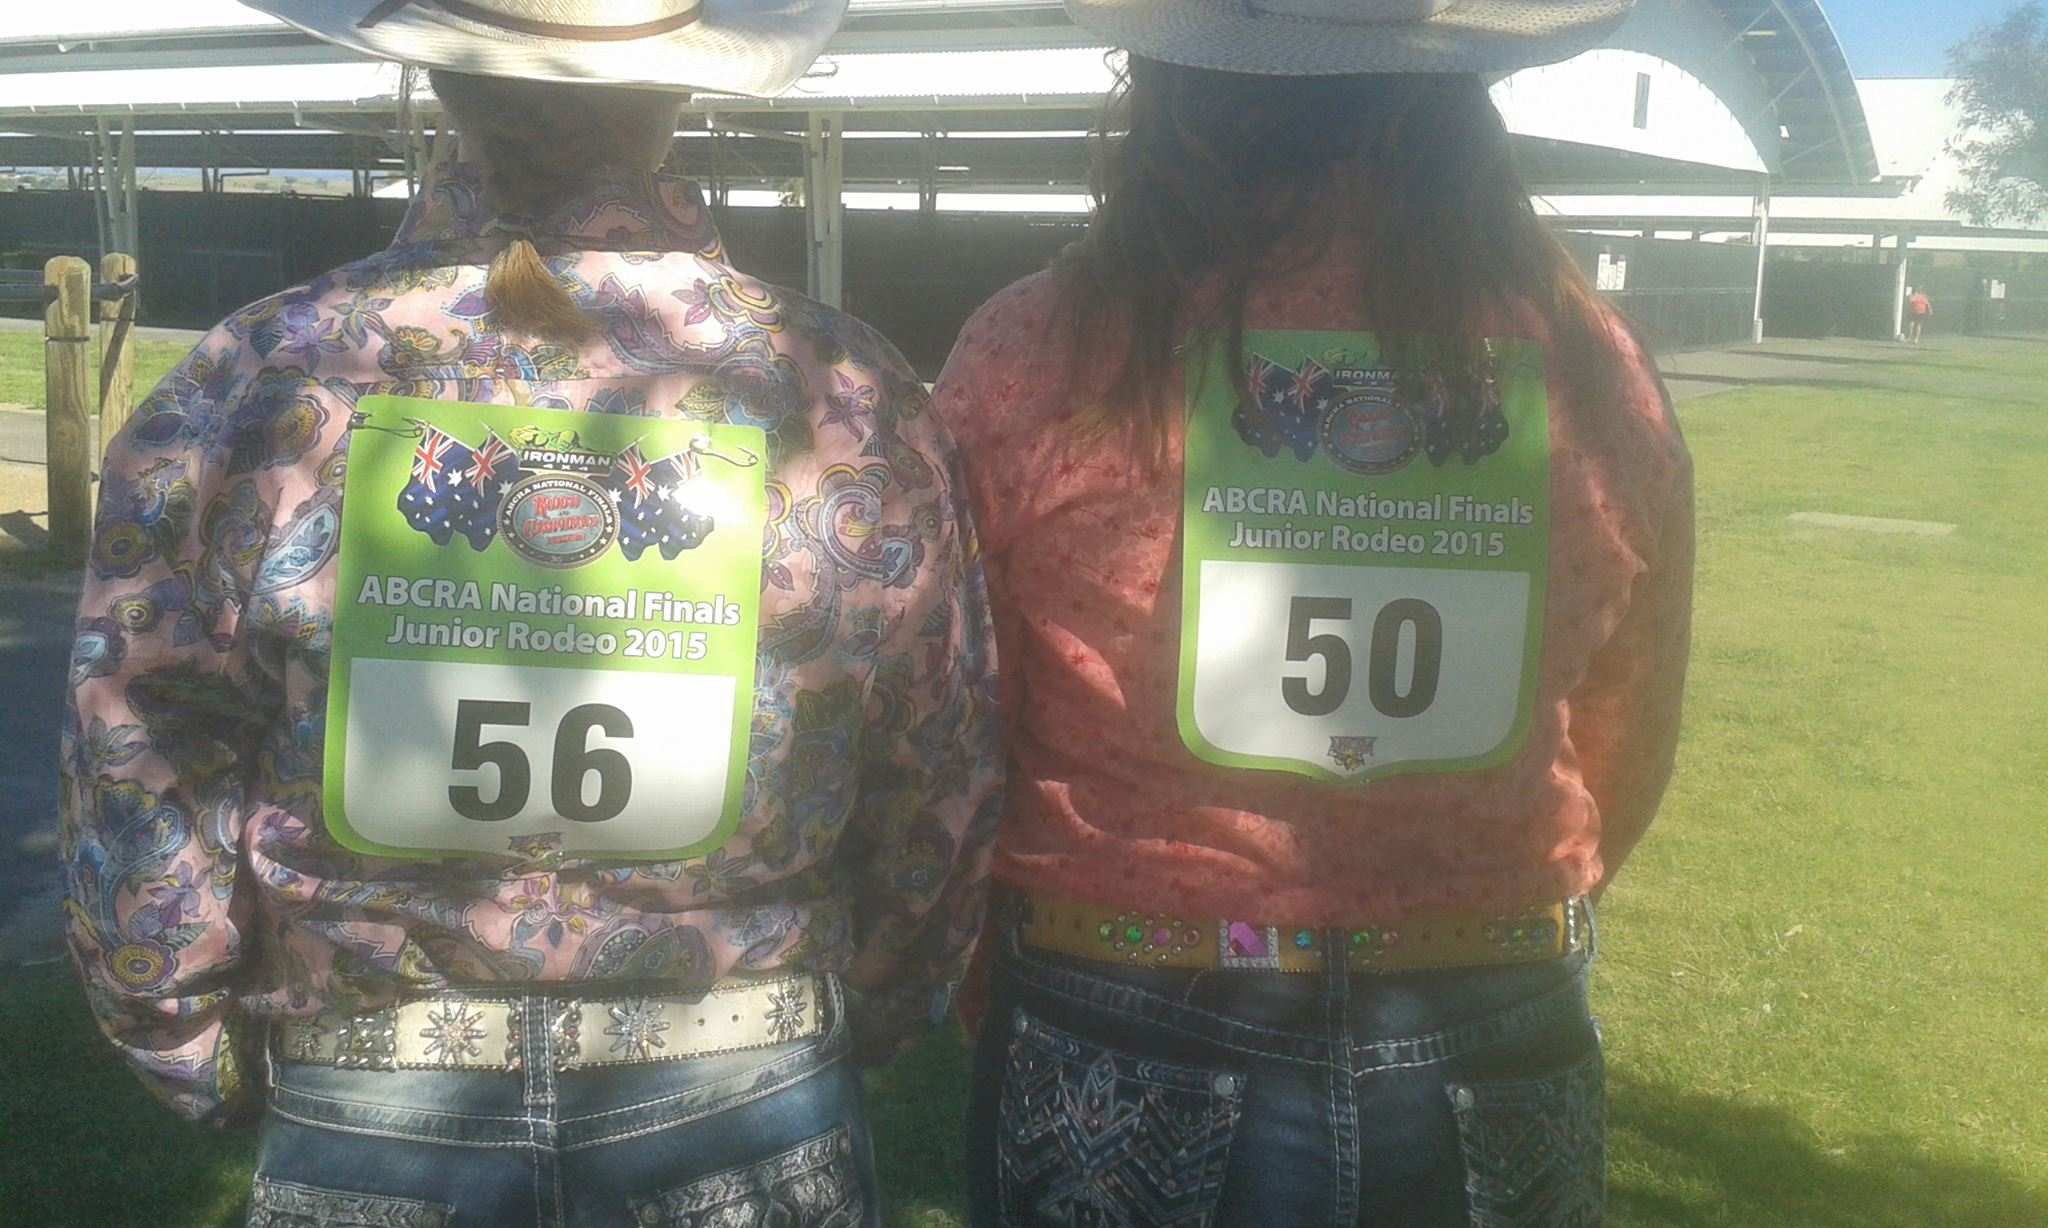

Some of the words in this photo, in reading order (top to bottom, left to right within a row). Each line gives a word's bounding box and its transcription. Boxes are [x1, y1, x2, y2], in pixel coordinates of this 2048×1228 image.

[523, 451, 610, 465] IRONMAN
[532, 480, 586, 491] NATIONAL
[588, 487, 613, 523] FINALS
[1202, 486, 1309, 516] ABCRA
[1316, 490, 1441, 520] National
[1449, 495, 1534, 524] Finals
[1229, 521, 1325, 550] Junior
[1331, 524, 1425, 554] Rodeo
[1431, 529, 1505, 557] 2015
[357, 574, 482, 610] ABCRA
[489, 581, 638, 621] National
[643, 590, 741, 626] Finals
[386, 614, 501, 649] Junior
[506, 620, 617, 656] Rodeo
[622, 627, 708, 661] 2015
[1281, 595, 1443, 719] 50
[448, 698, 635, 823] 56
